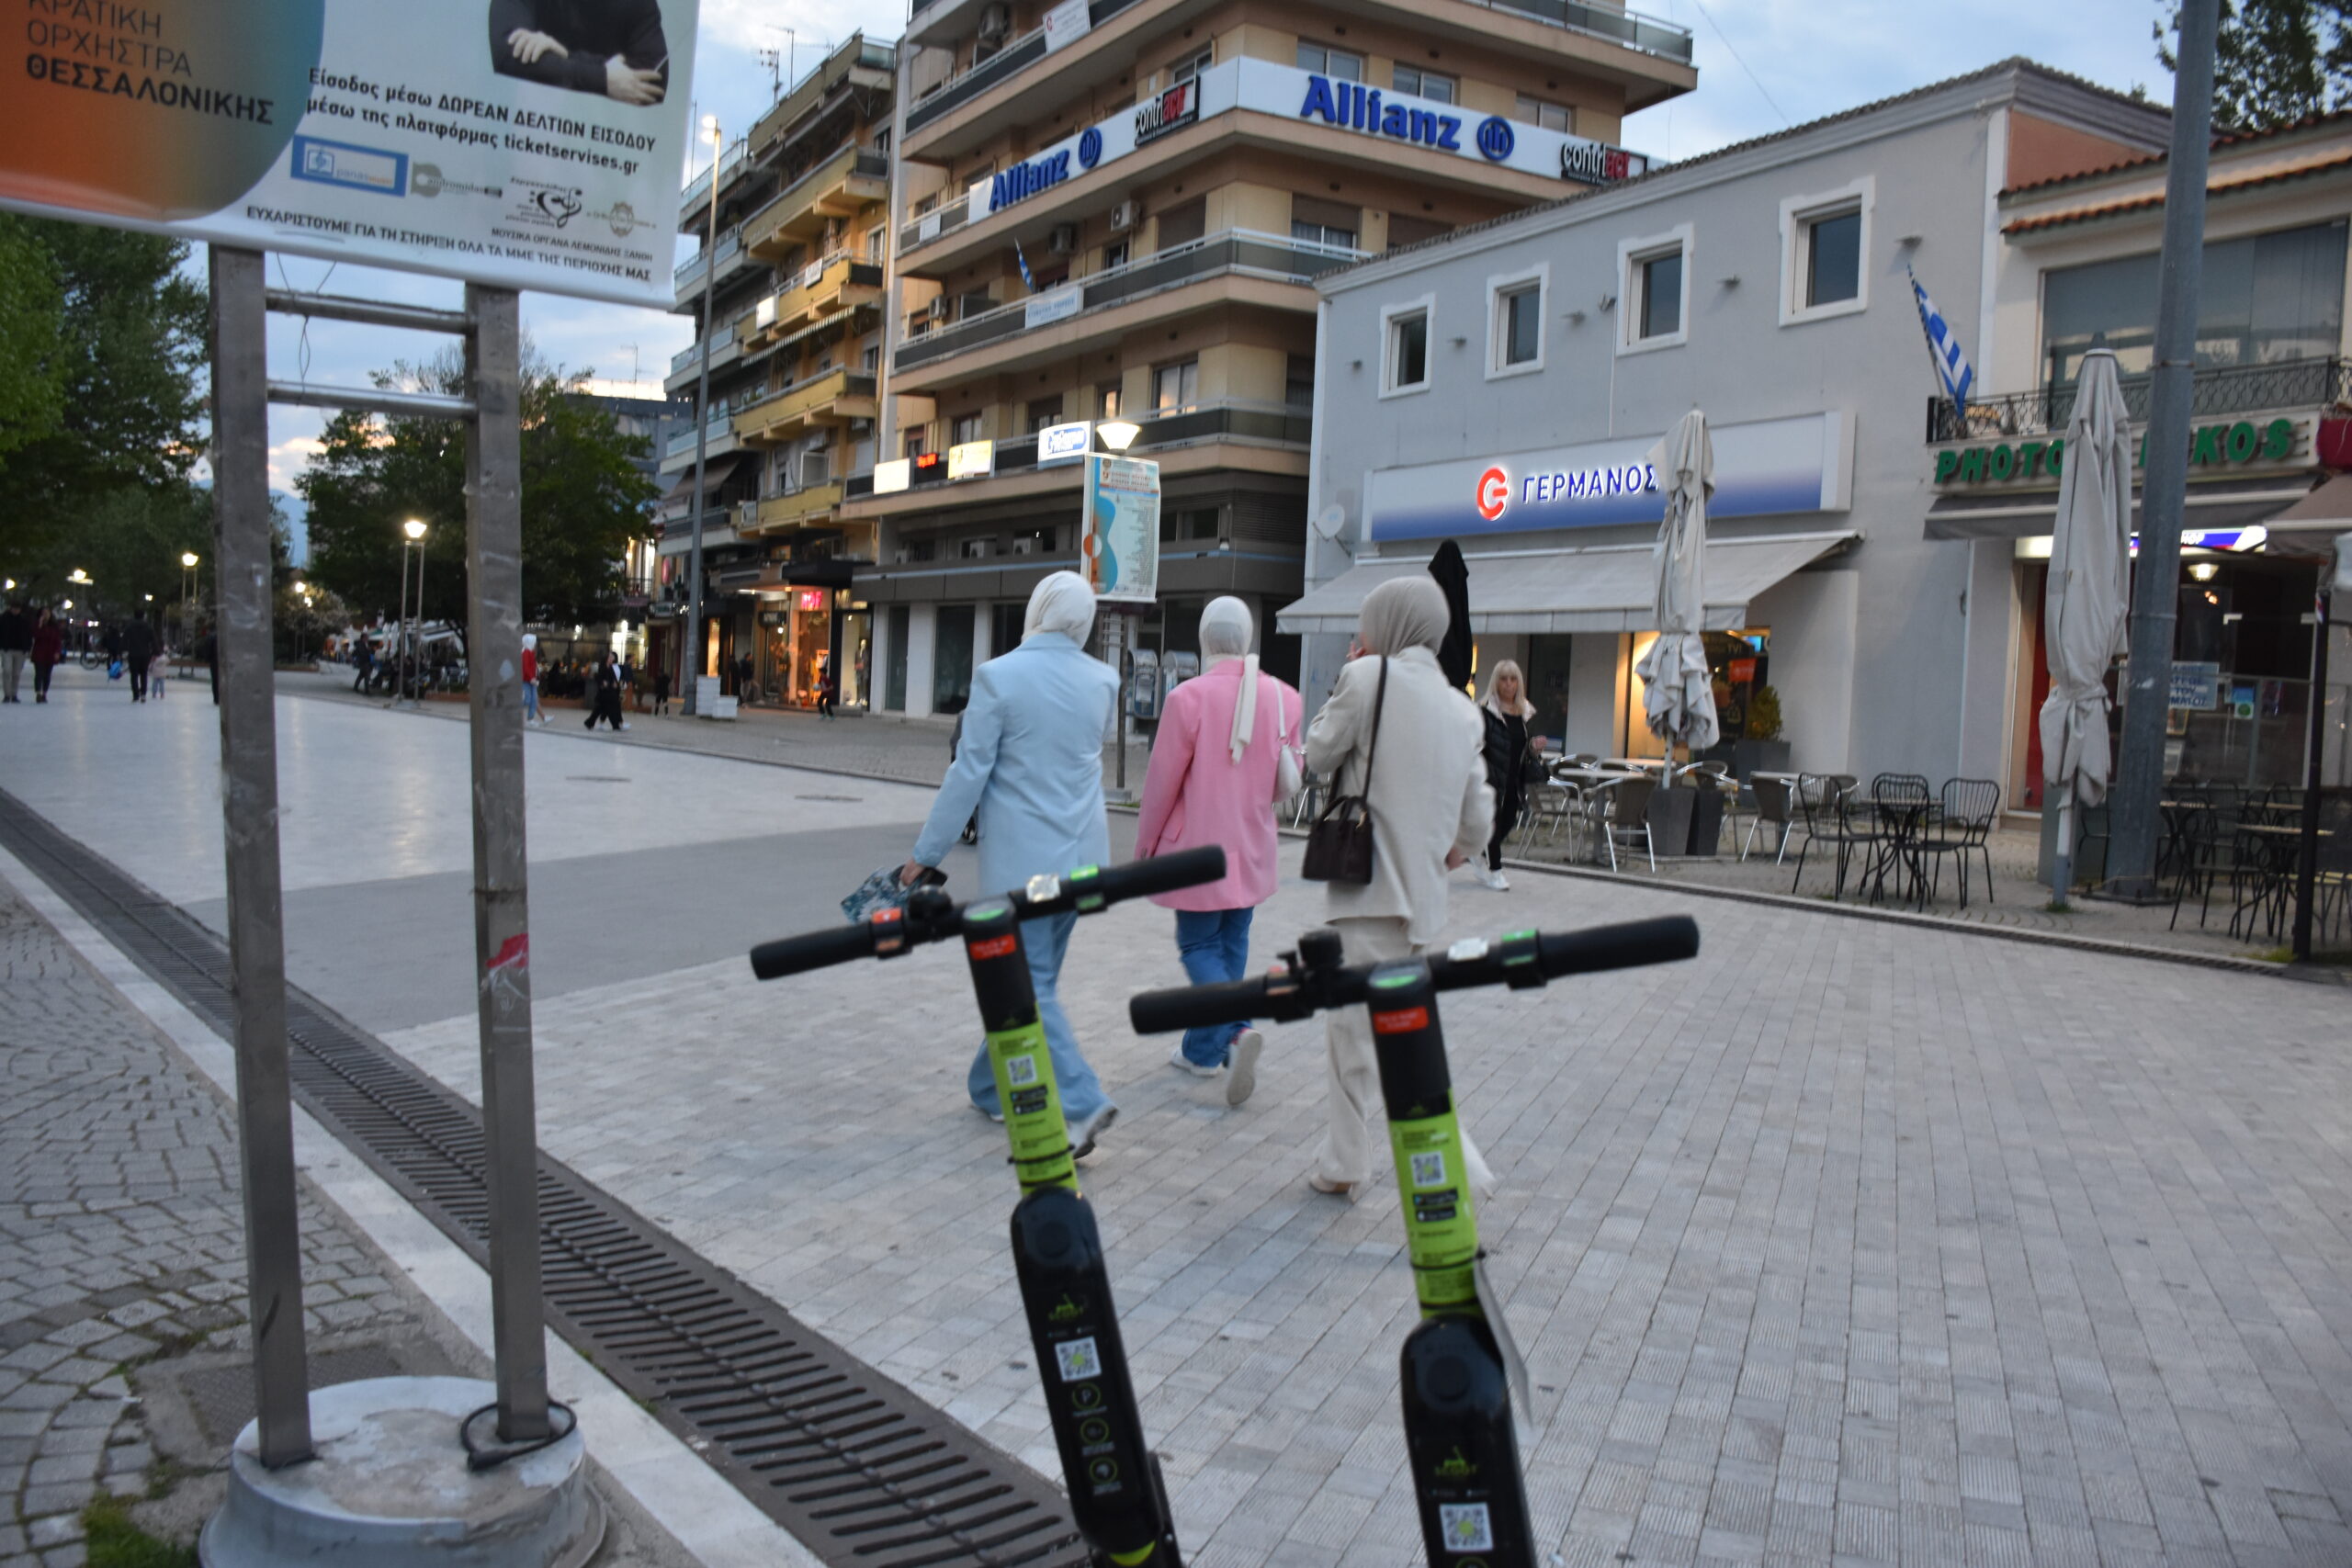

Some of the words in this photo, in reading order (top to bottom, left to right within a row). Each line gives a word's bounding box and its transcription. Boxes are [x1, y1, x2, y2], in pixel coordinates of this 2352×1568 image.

[27, 18, 192, 77] ΟΡΧΗΣΤΡΑ
[26, 52, 274, 126] ΘΕΣΣΑΛΟΝΙΚΗΣ
[309, 68, 379, 99] Είσοδος
[386, 85, 432, 107] μέσω
[437, 94, 508, 122] ΔΩΡΕΑΝ
[514, 109, 585, 138] ΔΕΛΤΙΩΝ
[591, 125, 656, 152] ΕΙΣΟΔΟΥ
[1300, 74, 1463, 151] Allianz
[307, 96, 355, 118] μέσω
[362, 107, 390, 129] της
[396, 113, 497, 150] πλατφόρμας
[504, 133, 639, 175] ticketservises.gr
[989, 150, 1069, 211] Allianz
[247, 206, 352, 234] ΕΥΧΑΡΙΣΤΟΥΜΕ
[355, 222, 376, 240] ΓΙΑ
[380, 227, 397, 242] ΤΗ
[400, 229, 455, 251] ΣΤΗΡΙΞΗ
[458, 239, 484, 255] ΟΛΑ
[487, 243, 503, 257] ΤΑ
[506, 248, 535, 262] ΜΜΕ
[537, 252, 560, 265] ΤΗΣ
[563, 256, 623, 276] ΠΕΡΙΟΧΗΣ
[626, 266, 651, 282] ΜΑΣ
[492, 228, 531, 243] ΜΟΥΣΙΚΑ
[533, 235, 570, 249] ΟΡΓΑΝΑ
[1522, 463, 1659, 504] ΓΕΡΜΑΝΟΣ
[1934, 438, 2064, 484] PHOTO
